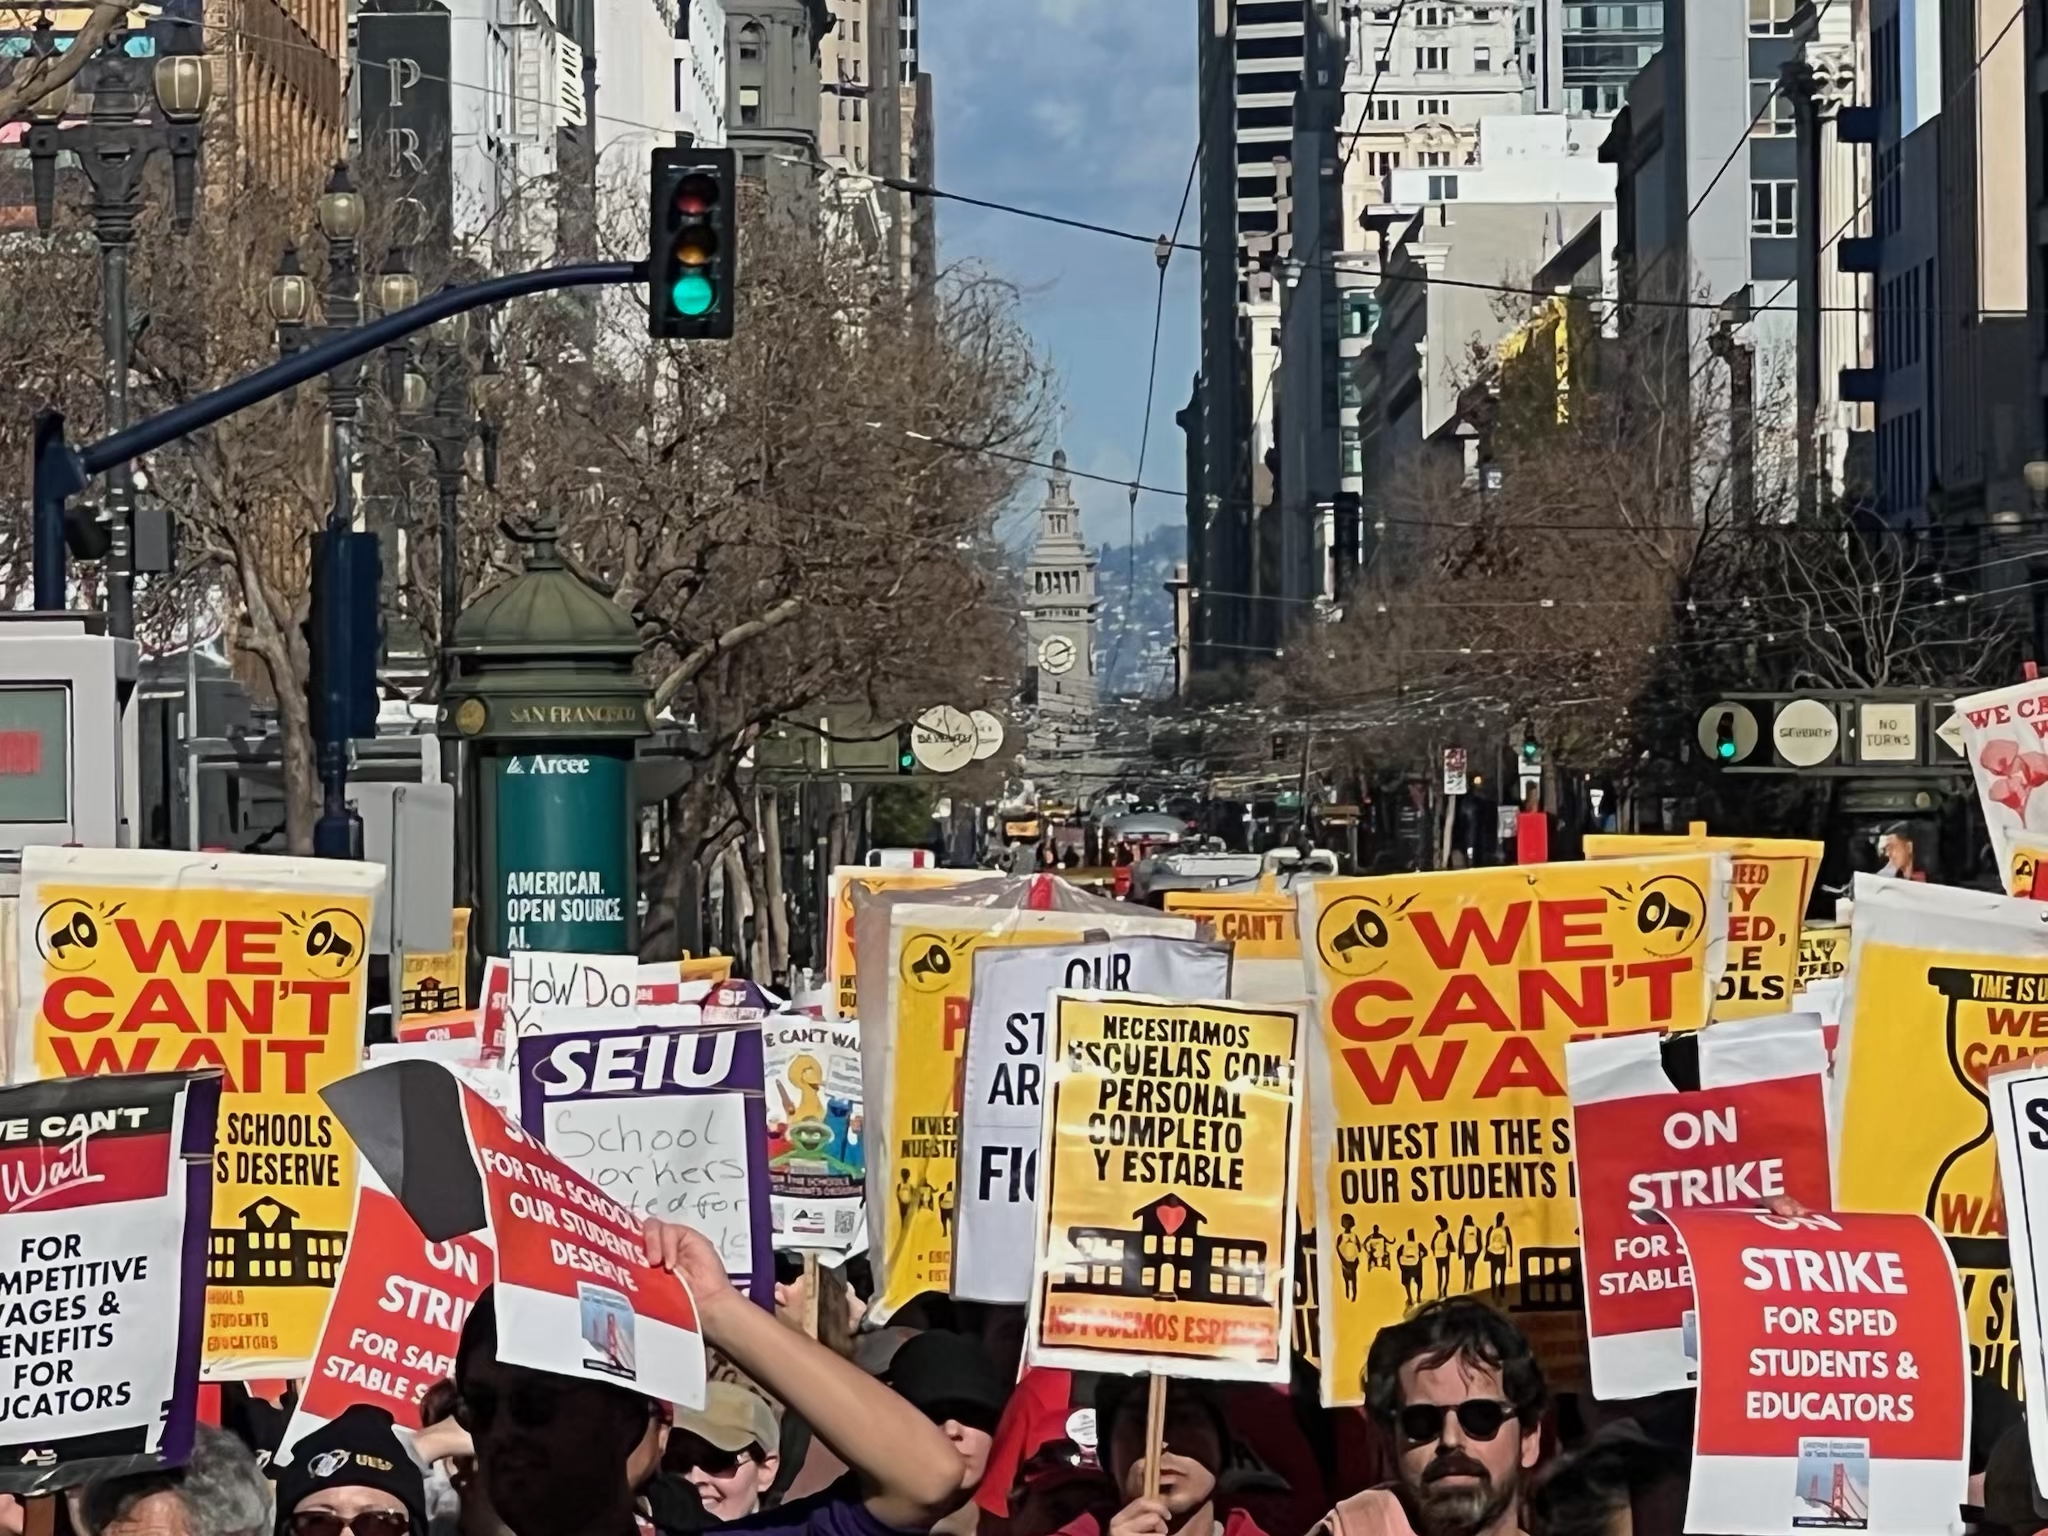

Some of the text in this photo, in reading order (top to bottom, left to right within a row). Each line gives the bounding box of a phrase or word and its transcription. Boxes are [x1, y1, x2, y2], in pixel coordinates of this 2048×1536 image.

[511, 706, 546, 722] SAN
[1879, 720, 1897, 730] NO
[1966, 705, 2011, 730] WE
[530, 755, 590, 774] Arcee
[507, 871, 605, 895] AMERICAN.
[507, 898, 556, 922] OPEN
[114, 919, 283, 975] WE
[507, 926, 531, 949] AI.
[1407, 899, 1613, 970] WE
[1332, 957, 1692, 1043] CAN'T
[1971, 973, 2014, 999] TIME
[2016, 977, 2036, 1002] IS
[43, 976, 351, 1035] CAN'T
[1103, 1015, 1250, 1048] NECESITAMOS
[49, 1036, 325, 1093] WAIT
[544, 1030, 737, 1096] SEIU
[1098, 1078, 1247, 1119] PERSONAL
[41, 1107, 149, 1138] CAN'T
[227, 1112, 332, 1148] SCHOOLS
[555, 1109, 718, 1159] School
[1089, 1113, 1243, 1153] COMPLETO
[1337, 1122, 1440, 1162] INVEST
[1450, 1120, 1480, 1157] IN
[1490, 1118, 1543, 1155] THE
[1663, 1106, 1738, 1149] ON
[236, 1152, 340, 1187] DESERVE
[526, 1162, 567, 1200] THE
[591, 1158, 745, 1187] orkers
[1093, 1148, 1244, 1191] Y ESTABLE
[1341, 1167, 1399, 1204] OUR
[1411, 1161, 1557, 1202] STUDENTS
[1628, 1158, 1785, 1210] STRIKE
[21, 1233, 82, 1263] FOR
[510, 1192, 650, 1269] OUR STUDENTS
[1615, 1235, 1671, 1261] FOR
[425, 1239, 478, 1285] ON
[550, 1239, 639, 1292] DESERVE
[1741, 1248, 1908, 1294] STRIKE
[1599, 1265, 1692, 1296] STABLE
[98, 1290, 121, 1316] &
[1763, 1306, 1897, 1336] FOR SPED
[349, 1328, 399, 1362] FOR
[14, 1359, 73, 1389] FOR
[323, 1355, 410, 1400] STABLE
[1749, 1348, 1919, 1379] STUDENTS &
[1746, 1391, 1914, 1422] EDUCATORS
